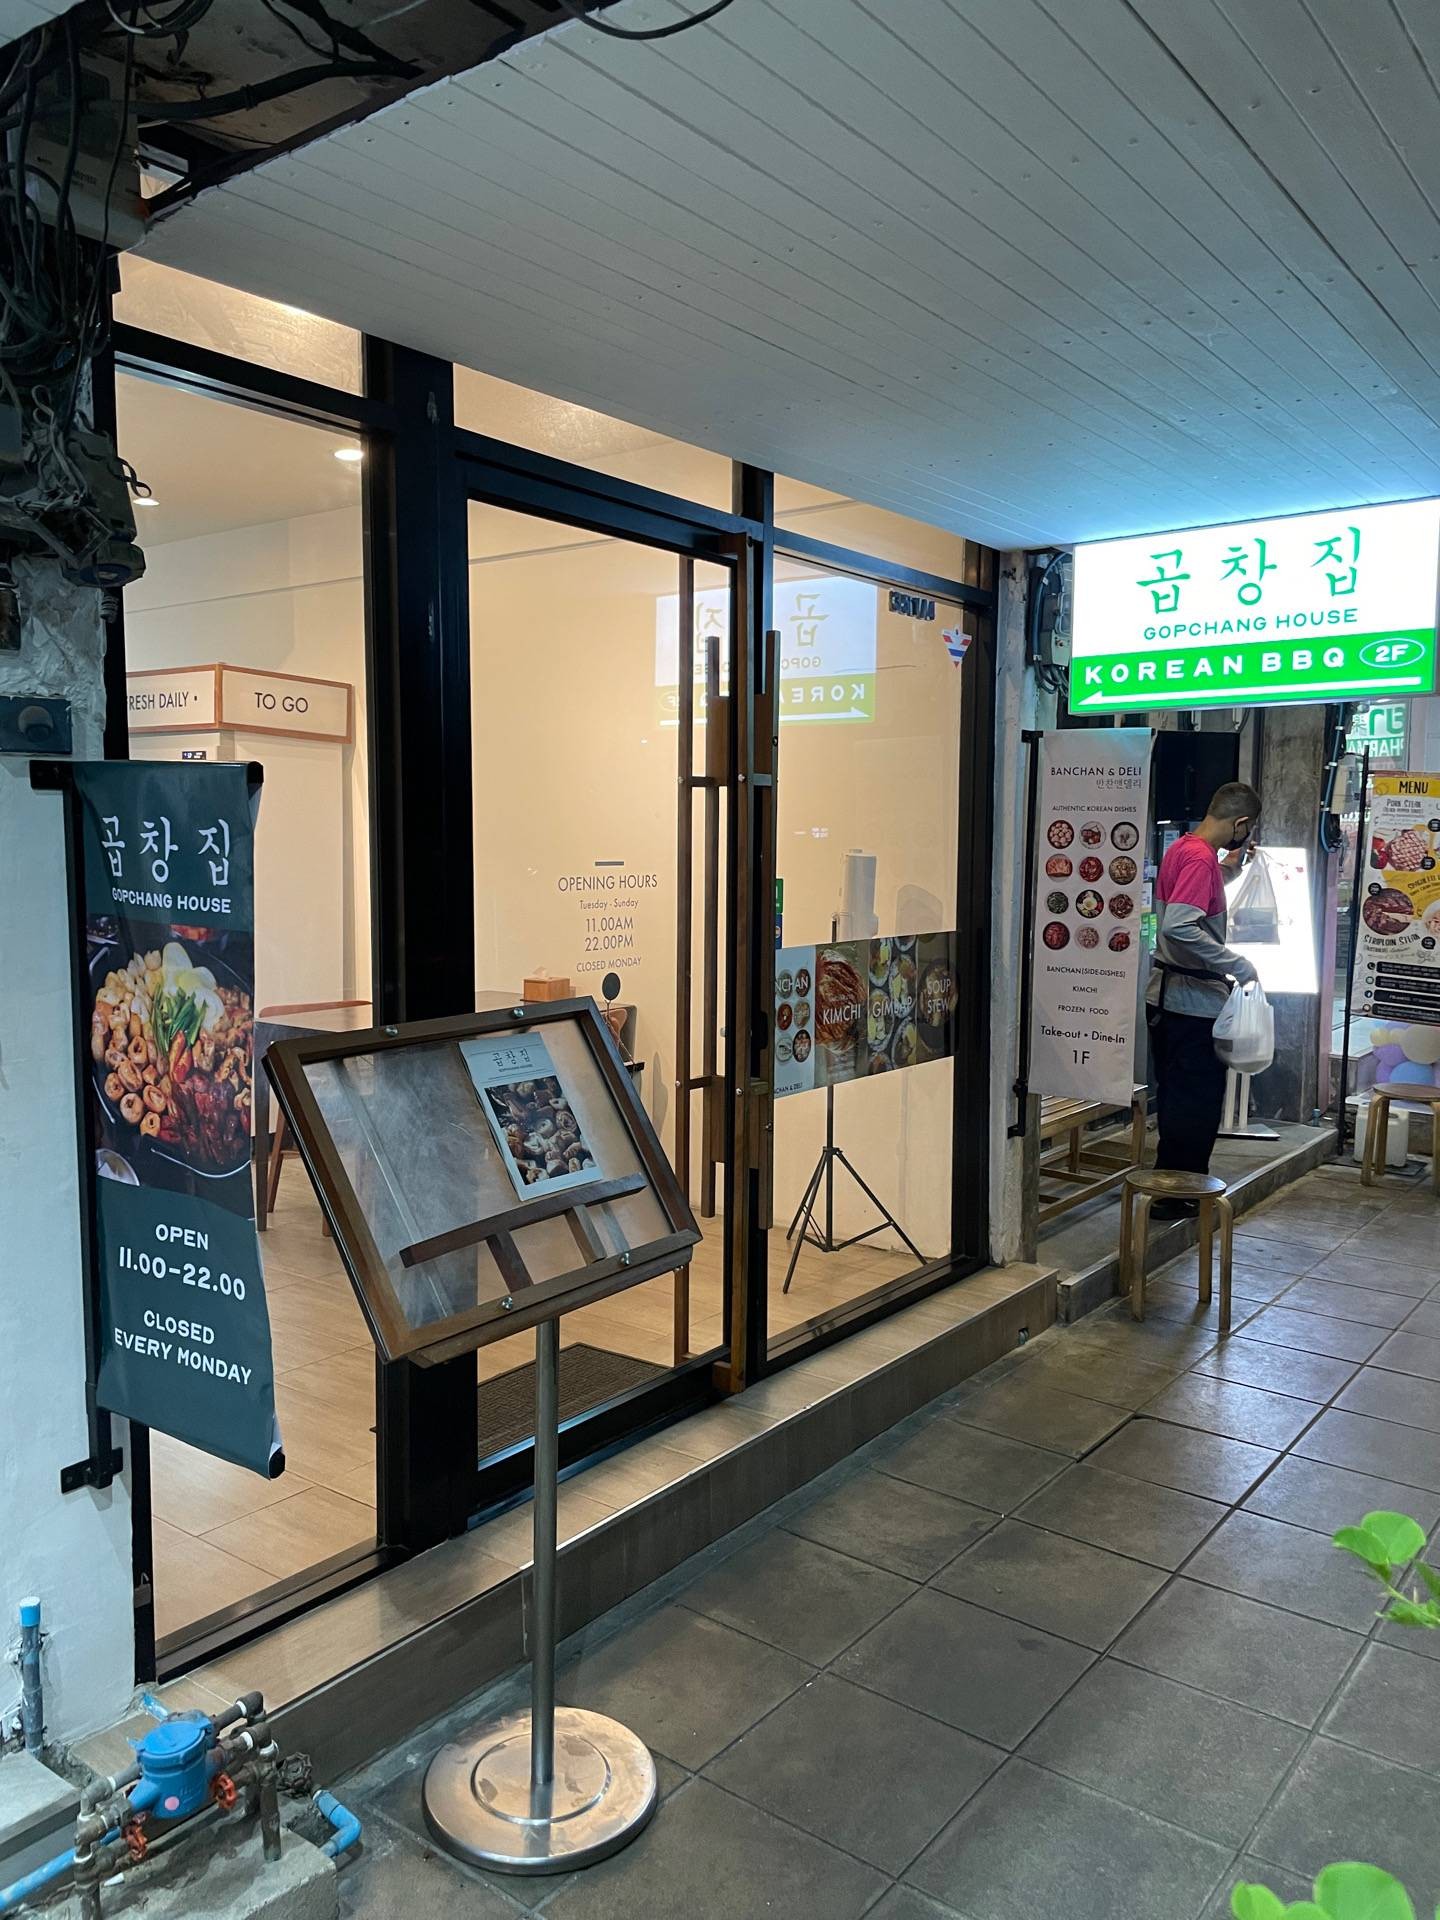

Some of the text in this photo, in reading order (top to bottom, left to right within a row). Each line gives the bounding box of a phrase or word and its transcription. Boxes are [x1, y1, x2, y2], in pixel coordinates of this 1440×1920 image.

[1136, 526, 1361, 614] 곱창집
[1143, 608, 1358, 641] GOPCHANG HOUSE
[1085, 643, 1408, 685] KOREAN BBQ 2F
[159, 691, 189, 708] DAILY
[254, 692, 309, 713] TO GO
[1051, 766, 1142, 776] BANCHAN & DELI
[1399, 781, 1429, 794] MENU
[101, 815, 231, 886] 곱창집
[558, 874, 658, 892] OPENING HOURS
[112, 887, 231, 913] GOPCHANG HOUSE
[580, 899, 608, 911] Tuesday
[614, 898, 640, 909] Sunday
[586, 916, 634, 933] 11.00AM
[585, 934, 634, 952] 22.00PM
[576, 957, 642, 973] CLOSED MONDAY
[927, 978, 951, 995] SOUP
[1072, 985, 1098, 993] KIMCHI
[822, 1003, 861, 1025] KIMCHI
[927, 997, 949, 1014] STEW
[1058, 1004, 1109, 1015] FROZEN FOOD
[1041, 1025, 1081, 1039] Take-out
[1072, 1050, 1091, 1065] 1F
[155, 1224, 209, 1251] OPEN
[143, 1310, 215, 1345] CLOSED
[114, 1328, 251, 1385] EVERY MONDAY
